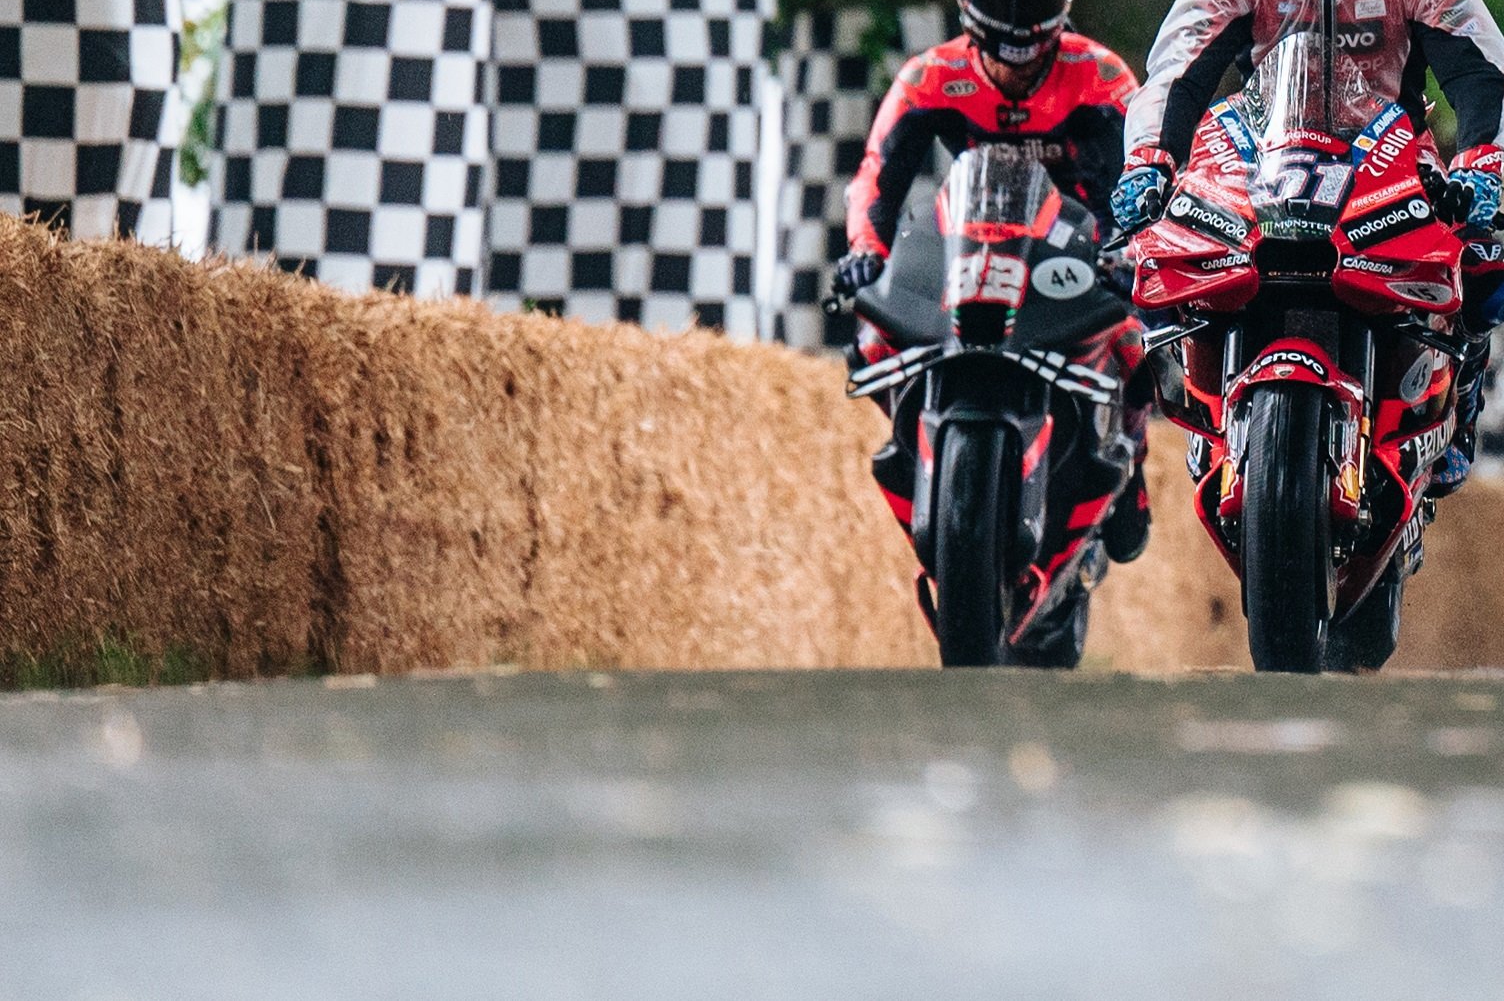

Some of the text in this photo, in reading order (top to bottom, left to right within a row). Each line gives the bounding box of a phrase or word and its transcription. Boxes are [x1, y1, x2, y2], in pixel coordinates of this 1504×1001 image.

[1372, 103, 1404, 137] ADVANCE
[1250, 162, 1353, 207] 51
[1351, 177, 1420, 208] FRECCIAROSSA
[1189, 206, 1248, 238] motorola
[1274, 218, 1332, 233] MONSTER
[1347, 209, 1410, 242] motorola
[1201, 254, 1250, 270] CARRERA
[1342, 257, 1393, 274] CARRERA
[1051, 264, 1079, 288] 44
[1250, 352, 1324, 375] Lenovo
